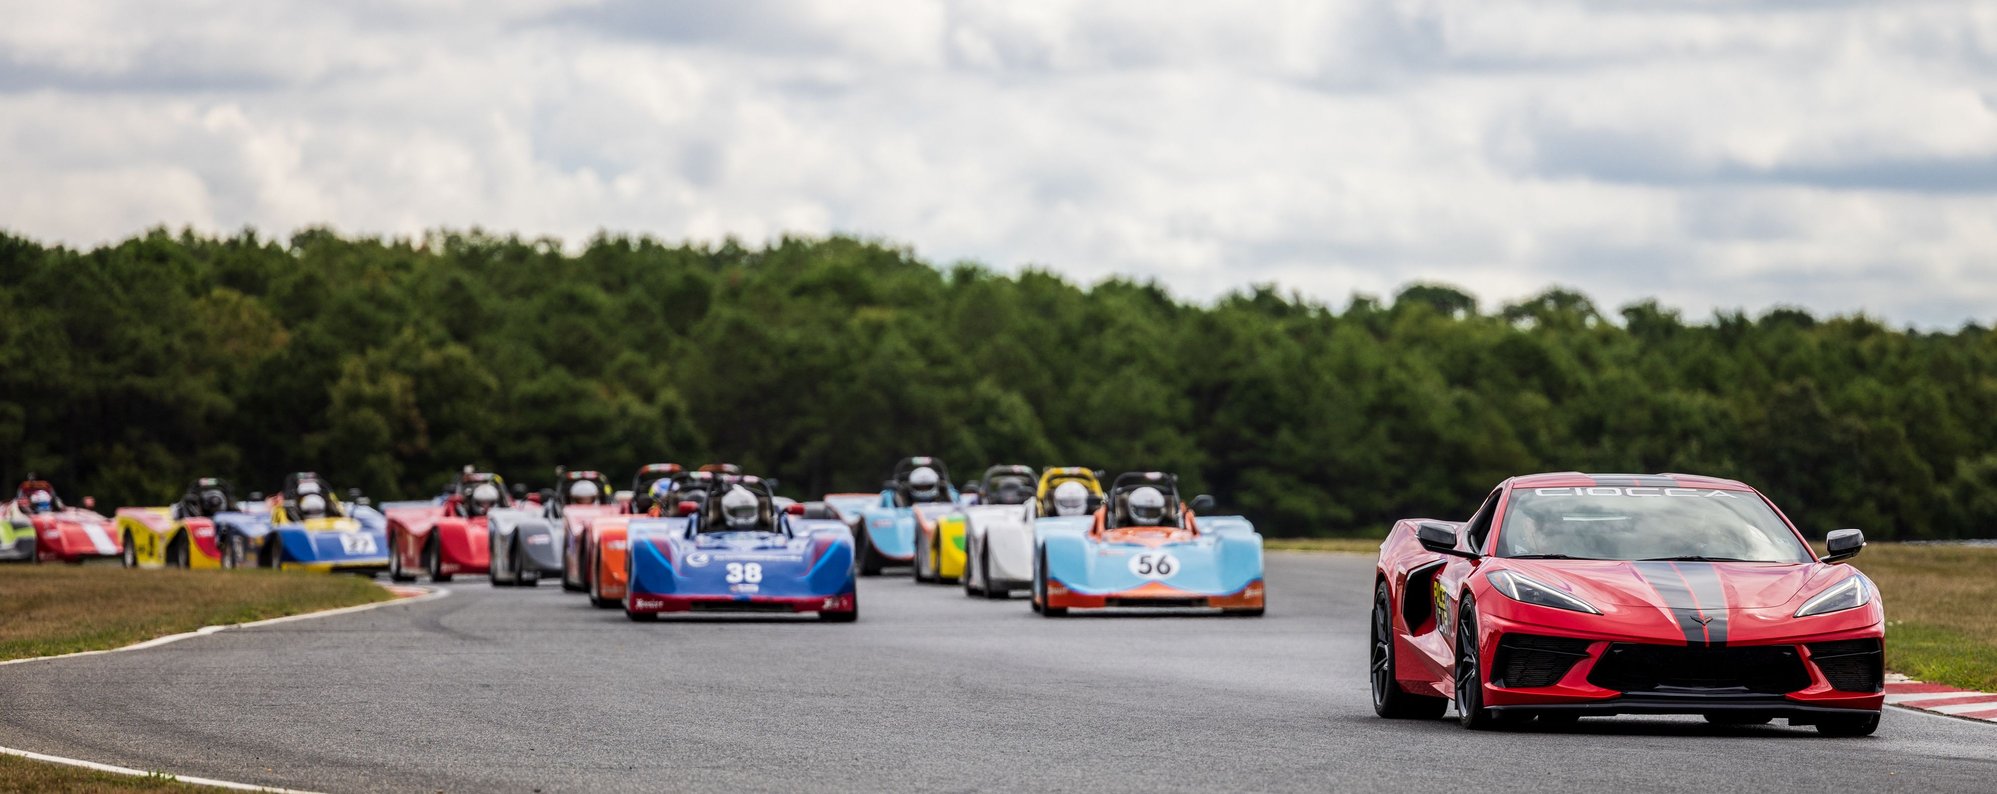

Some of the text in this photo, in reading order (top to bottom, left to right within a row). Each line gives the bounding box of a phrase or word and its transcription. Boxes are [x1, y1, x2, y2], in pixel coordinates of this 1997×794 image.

[1535, 487, 1737, 499] CIOCCA
[725, 562, 762, 584] 38
[1138, 555, 1171, 575] 56
